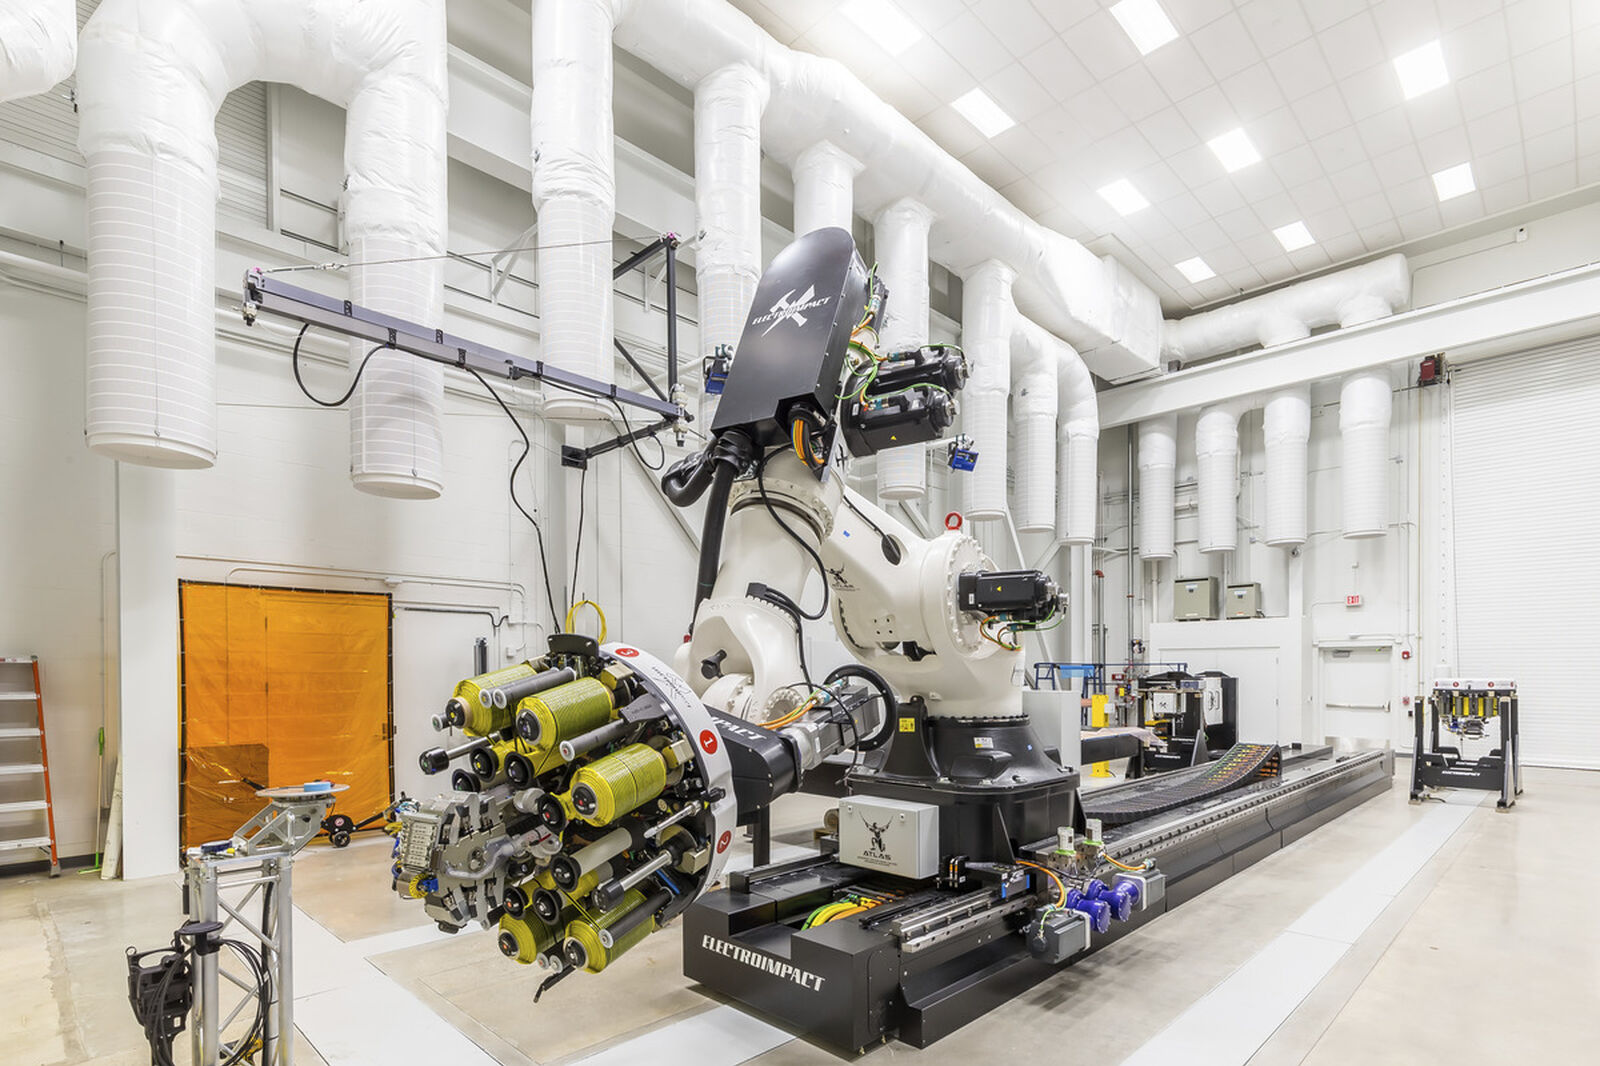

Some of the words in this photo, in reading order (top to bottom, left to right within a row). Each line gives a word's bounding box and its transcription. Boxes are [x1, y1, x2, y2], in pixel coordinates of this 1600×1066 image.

[1347, 595, 1360, 604] EXIT
[863, 850, 892, 861] ATLAS
[702, 934, 826, 992] ELECTROIMPACT
